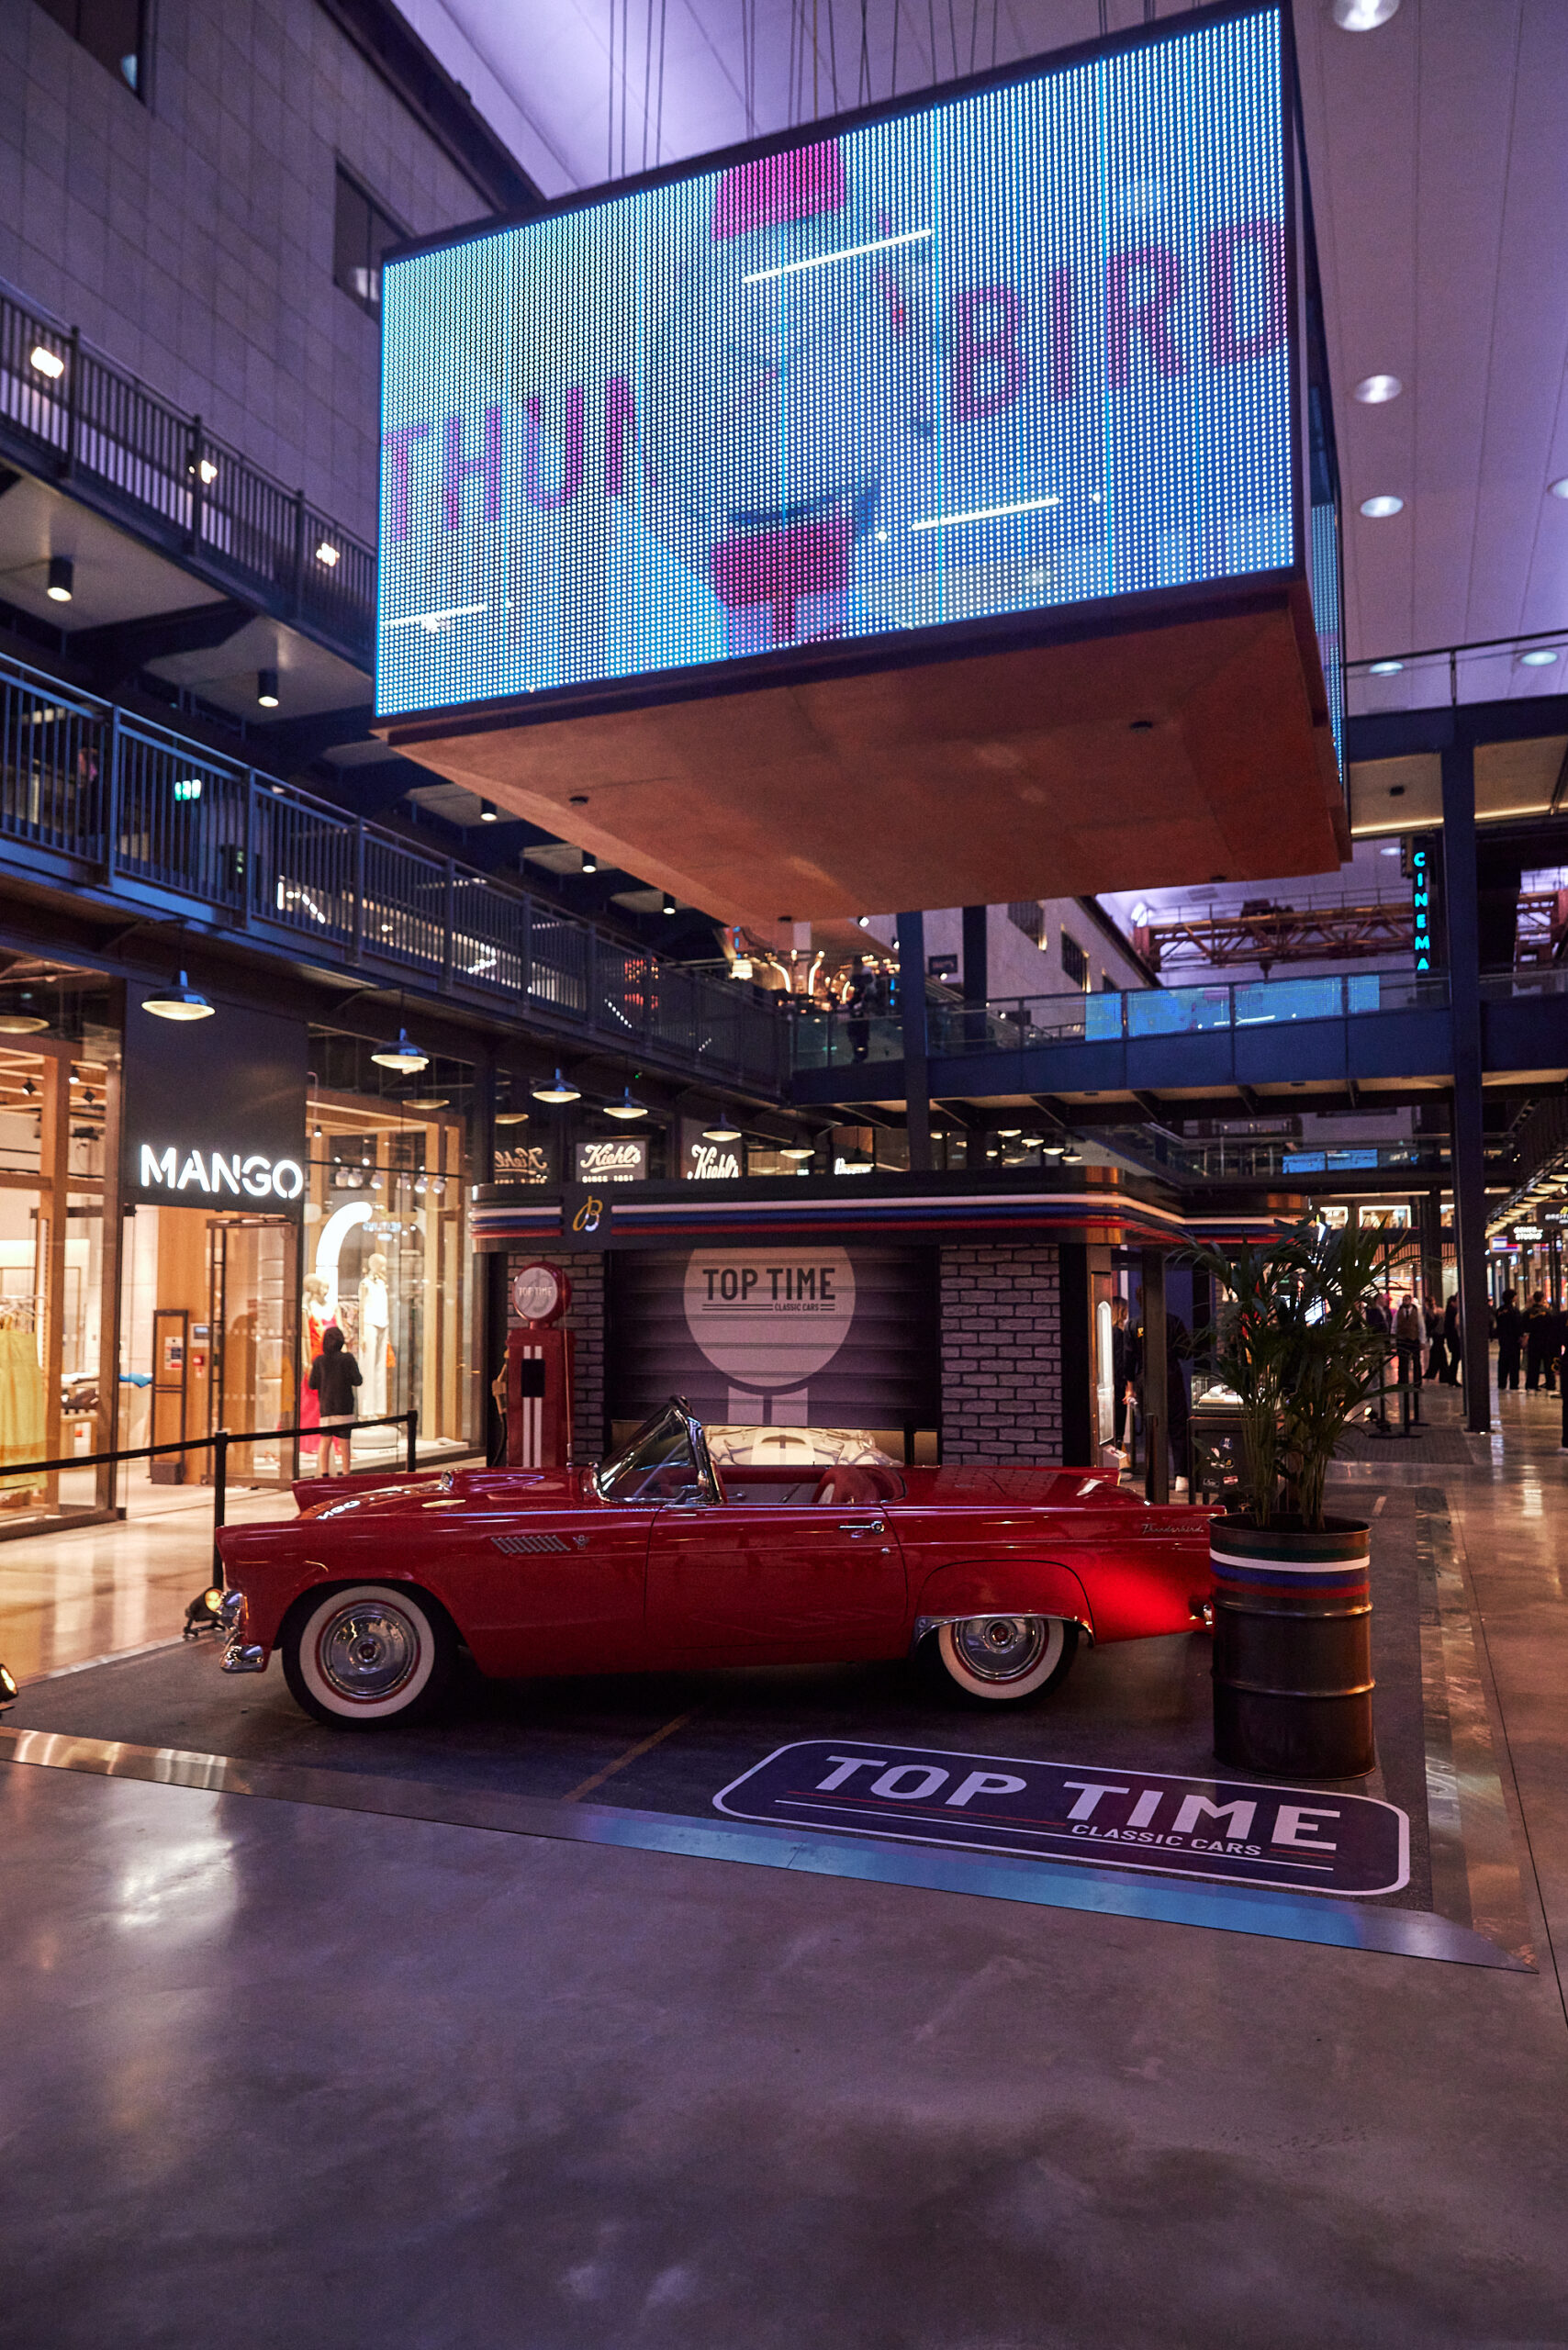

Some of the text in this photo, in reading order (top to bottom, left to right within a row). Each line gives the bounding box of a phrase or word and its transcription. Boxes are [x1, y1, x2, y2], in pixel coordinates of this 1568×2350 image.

[956, 217, 1287, 422] BIRD
[1413, 852, 1430, 970] CINEMA
[140, 1144, 304, 1200] MANGO
[580, 1143, 642, 1169] Kiehl's
[702, 1267, 836, 1301] TOP TIME
[774, 1303, 820, 1312] CLASSIC CARS
[814, 1754, 1341, 1851] TOP TIME
[1071, 1824, 1262, 1856] CLASSIC CARS
